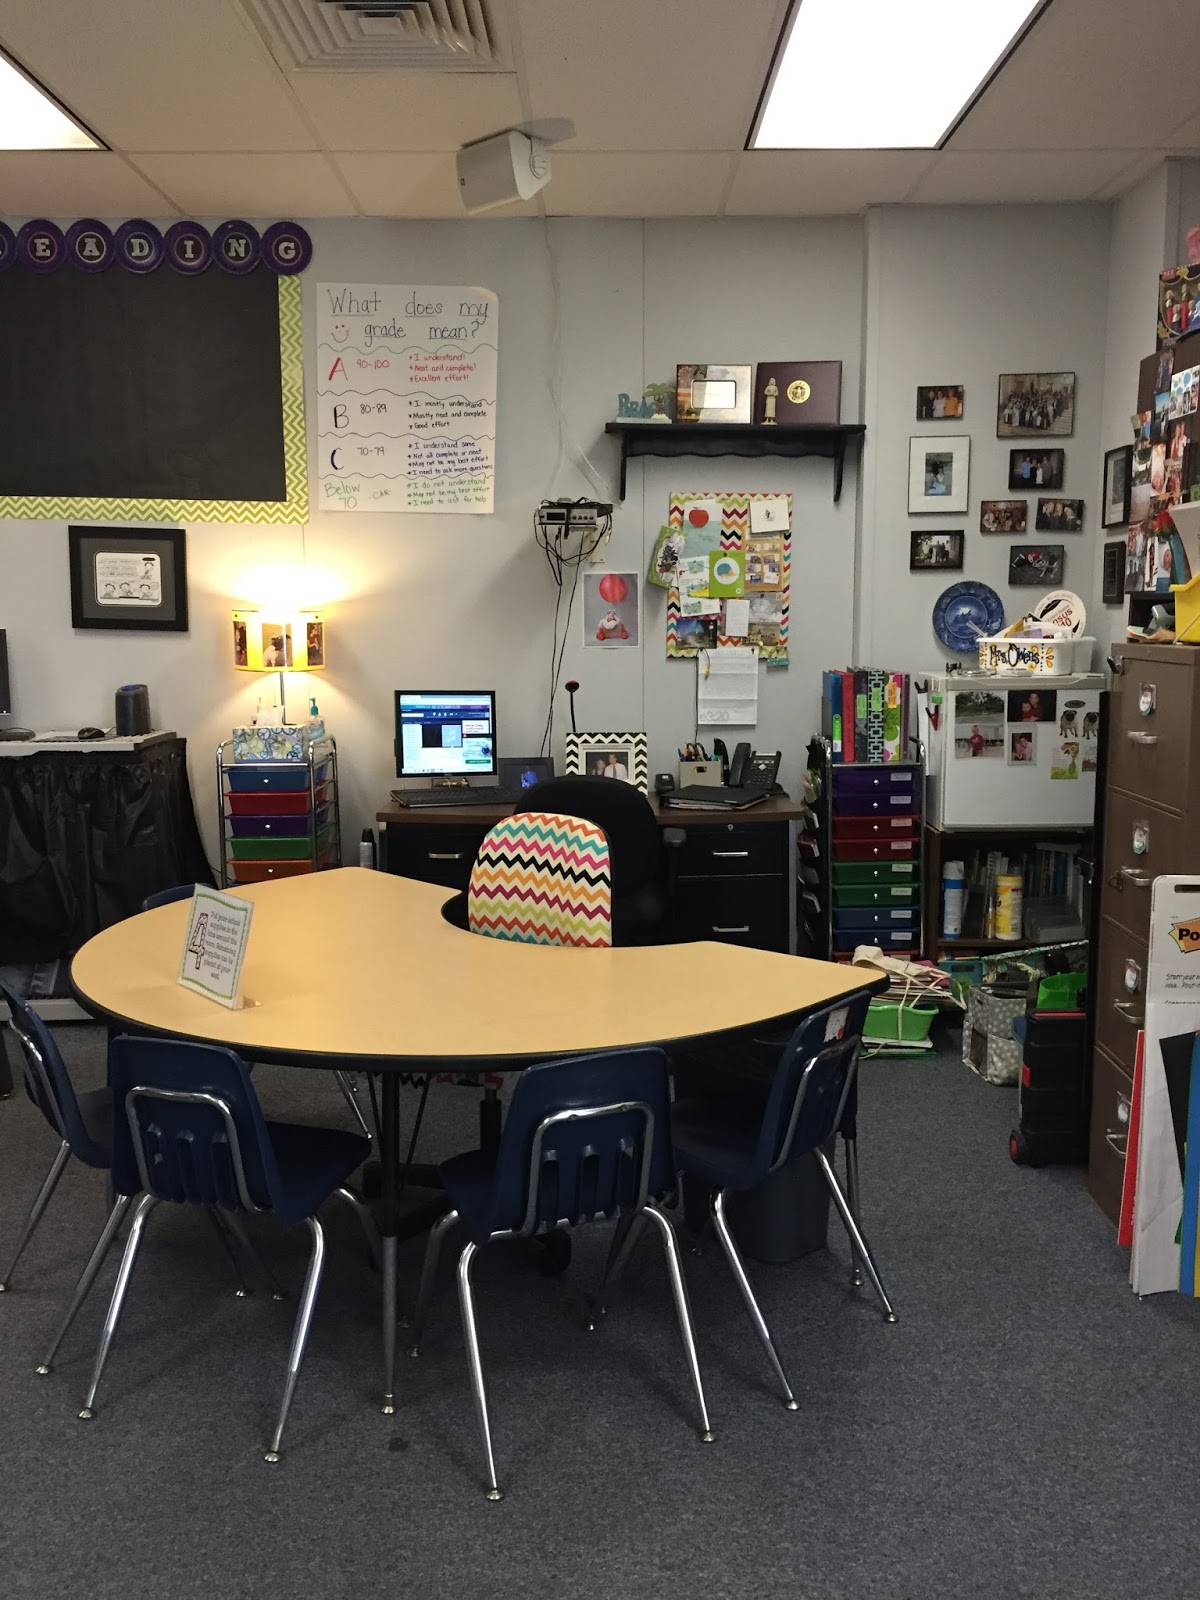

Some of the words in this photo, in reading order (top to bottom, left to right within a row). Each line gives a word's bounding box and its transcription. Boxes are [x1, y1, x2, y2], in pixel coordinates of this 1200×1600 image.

[0, 237, 296, 260] EADING
[327, 289, 381, 314] What
[405, 291, 442, 315] does
[459, 303, 488, 325] my
[364, 318, 406, 347] grade
[429, 319, 480, 338] mean?
[328, 357, 348, 381] A
[356, 359, 390, 370] 90-100
[446, 362, 476, 373] complete!
[445, 374, 469, 382] effort!
[359, 403, 387, 414] 80-89
[425, 401, 445, 409] mostly
[449, 400, 482, 408] understand
[333, 404, 349, 428] B
[413, 412, 433, 420] Mostly
[463, 410, 487, 418] complete
[357, 447, 385, 456] 70-79
[330, 447, 345, 471] C
[324, 481, 359, 497] Below
[339, 496, 357, 509] 70
[189, 913, 208, 970] 4
